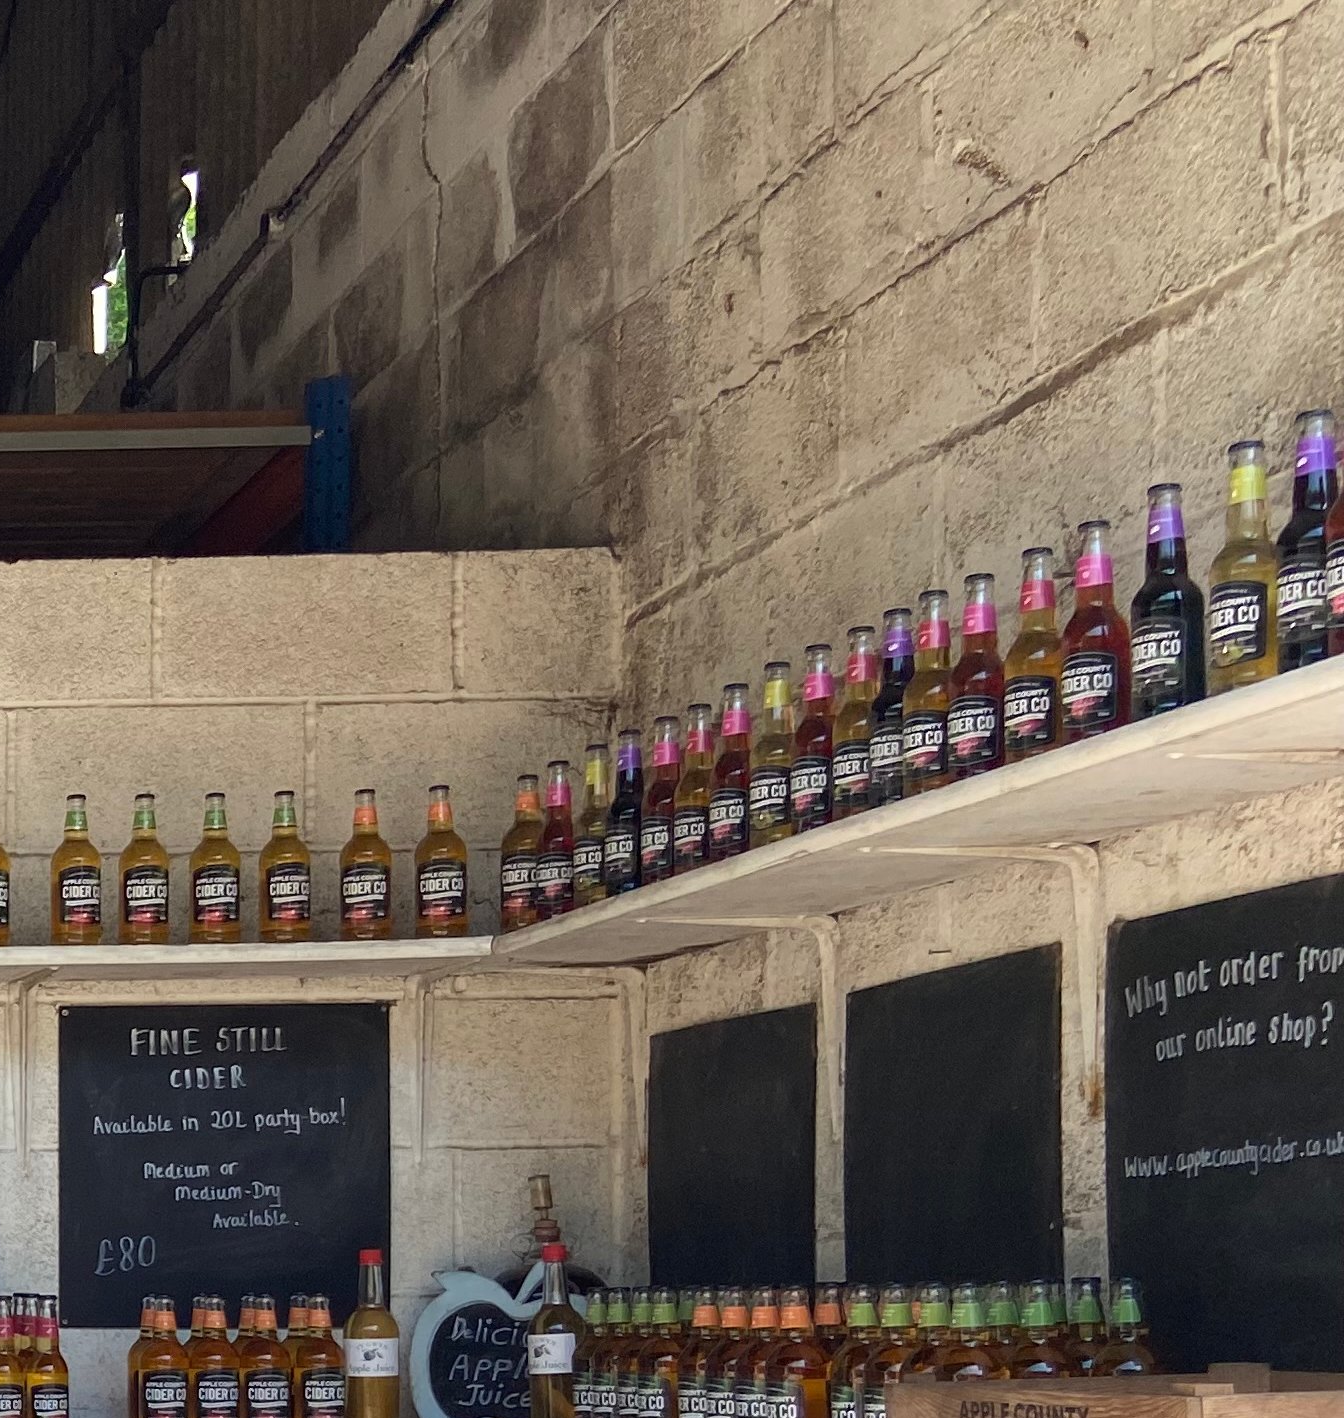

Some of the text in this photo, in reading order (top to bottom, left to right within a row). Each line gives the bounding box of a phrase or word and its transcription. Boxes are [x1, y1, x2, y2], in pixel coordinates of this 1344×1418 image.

[1125, 975, 1167, 1018] Why
[1174, 960, 1212, 998] not
[1220, 951, 1284, 988] order
[130, 1027, 288, 1056] FINE STILL
[1155, 1030, 1187, 1062] our
[1195, 1017, 1256, 1052] online
[169, 1065, 247, 1090] CIDER
[93, 1116, 173, 1135] Available
[183, 1116, 199, 1131] in
[144, 1162, 239, 1180] Medium or
[94, 1235, 156, 1277] £80
[458, 1383, 531, 1409] Juice
